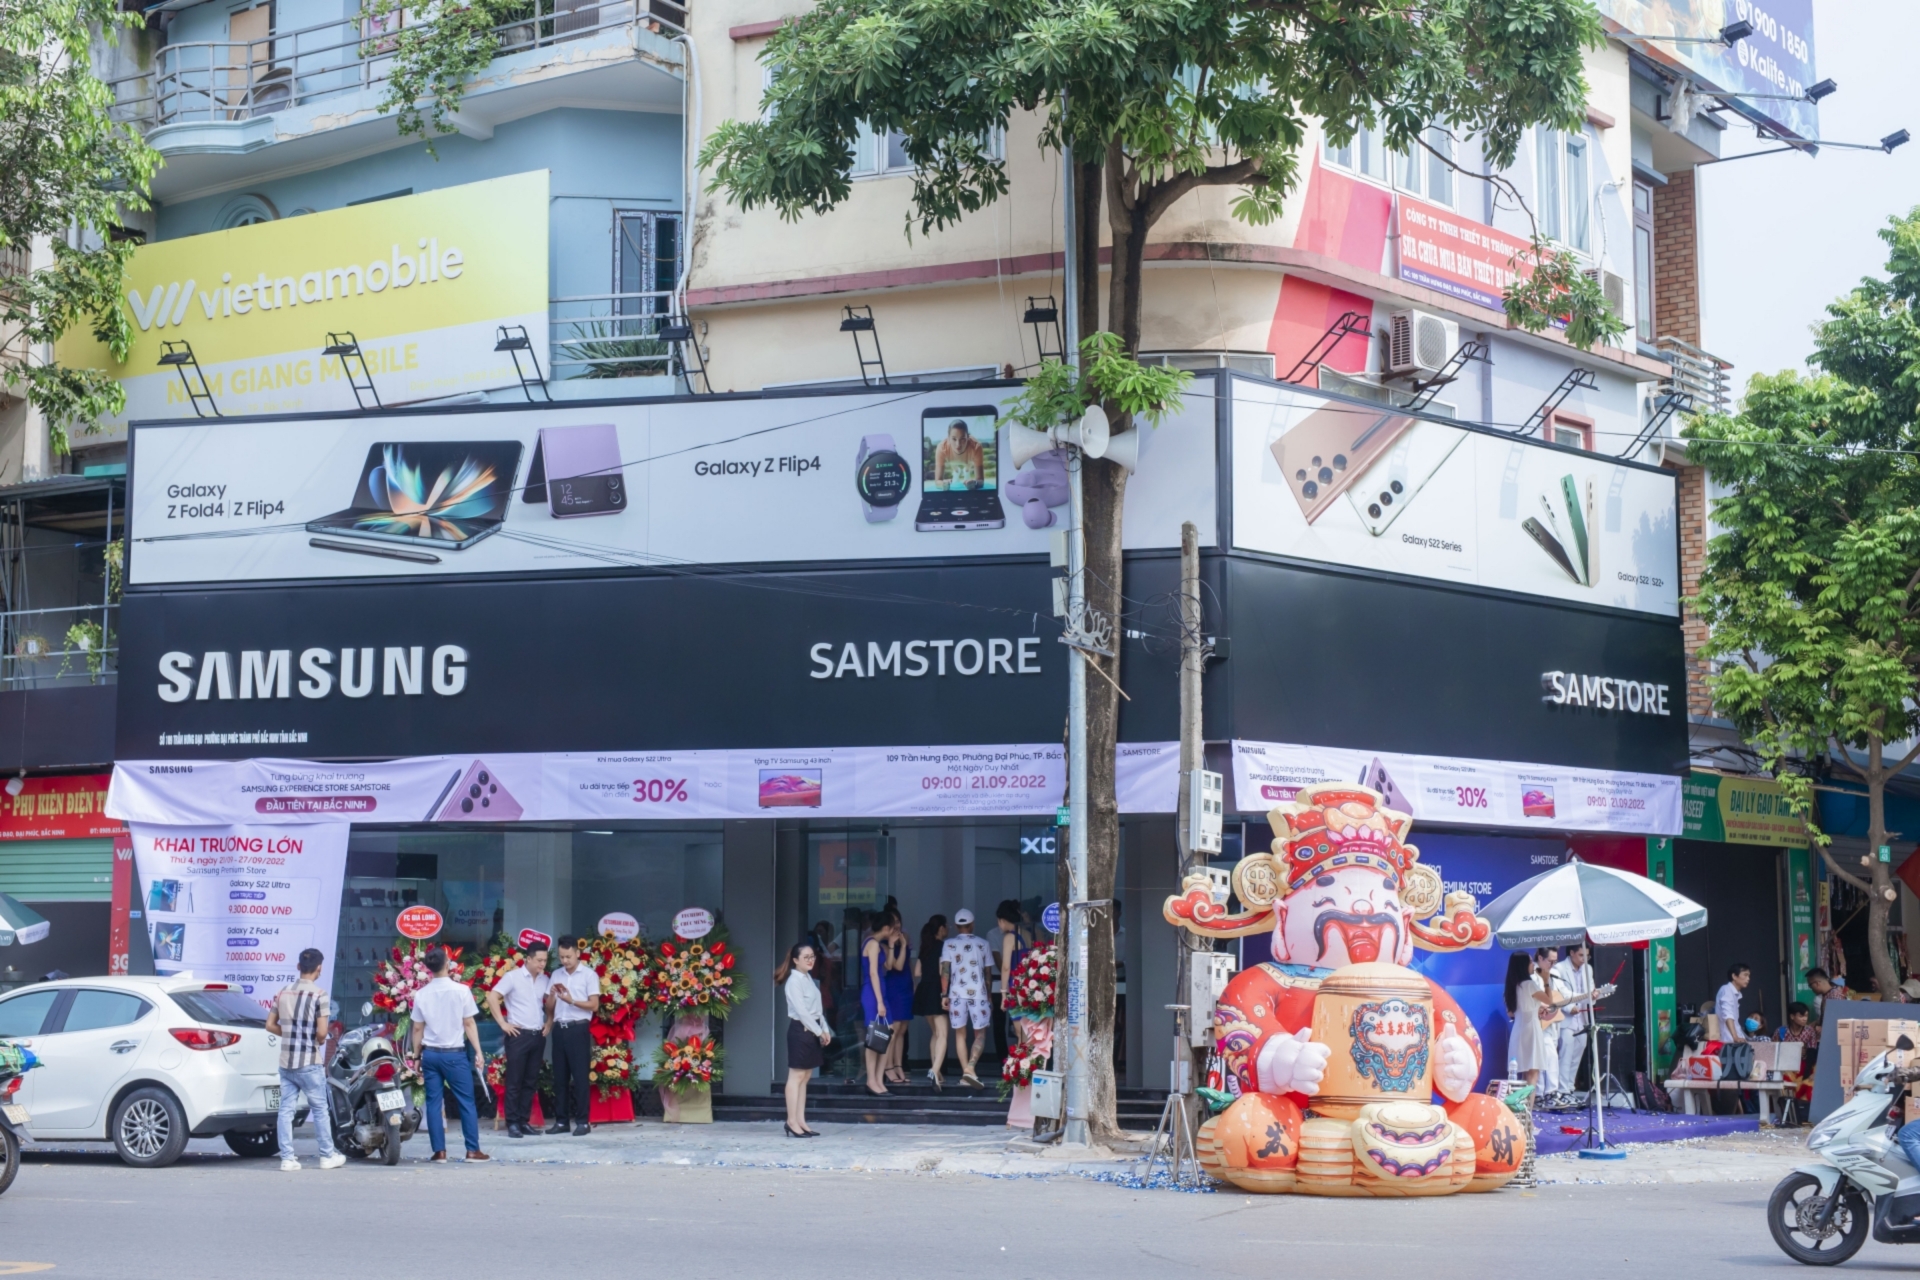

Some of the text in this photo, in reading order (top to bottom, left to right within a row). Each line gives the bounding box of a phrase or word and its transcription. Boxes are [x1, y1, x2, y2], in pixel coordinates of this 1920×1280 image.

[1748, 1, 1808, 64] 1900 1850
[1750, 45, 1803, 98] Kalite.vn
[1406, 206, 1426, 227] CÔNG
[1427, 215, 1437, 231] TY
[199, 238, 464, 320] vietnamobile
[166, 343, 419, 405] NAM GIANG MOBILE
[695, 455, 821, 477] Galaxy Z Flip4
[167, 484, 227, 500] Galaxy
[168, 500, 285, 519] Z Fold4 Z Flip4
[1402, 533, 1462, 552] Galaxy S22 Series
[1618, 571, 1639, 586] Galaxy
[1640, 575, 1650, 585] S22
[810, 637, 1042, 680] SAMSTORE
[157, 644, 468, 703] SAMSUNG
[1548, 670, 1671, 716] SAMSTORE
[886, 754, 899, 762] 109
[900, 753, 919, 762] Trần
[920, 754, 941, 763] Hưng
[962, 753, 993, 763] Phường
[994, 753, 1008, 762] Đại
[1009, 752, 1032, 760] Phúc,
[1033, 752, 1045, 760] TP.
[1046, 750, 1062, 760] Bắc
[149, 765, 193, 774] SAMSUNG
[947, 763, 1020, 773] Một Ngày Duy Nhất
[350, 783, 391, 791] SAMSTORE
[922, 775, 1046, 790] 09:00 21.09.2022
[632, 779, 688, 802] 30%
[1456, 786, 1488, 808] 30%
[12, 787, 94, 821] PHỤ KIỆN ĐIỆN
[266, 797, 367, 812] ĐẦU TIÊN TẠI BẮC NINH
[1587, 796, 1646, 810] 09:00 21.09.2022
[1730, 789, 1744, 817] ĐẠI
[1745, 788, 1757, 813] LÝ
[1757, 793, 1773, 819] GẠO
[153, 837, 195, 852] KHAI
[267, 835, 303, 854] LỚN
[197, 856, 217, 866] ngày
[239, 856, 286, 865] 27/09/2022
[1530, 855, 1559, 865] SAMSTORE
[187, 866, 267, 876] Samsung Store
[229, 880, 291, 889] Galaxy S22 Ultra
[1468, 882, 1492, 894] STORE
[228, 904, 293, 915] 9.300.000 VNĐ
[421, 913, 436, 921] LONG
[1522, 912, 1571, 922] SAMSTORE
[227, 927, 279, 936] Galaxy Z Fold 4
[1502, 933, 1582, 945] http://samstore.com.vn
[111, 953, 129, 971] 3G
[226, 952, 286, 961] 7.000.000 VNĐ
[236, 974, 259, 983] Galaxy
